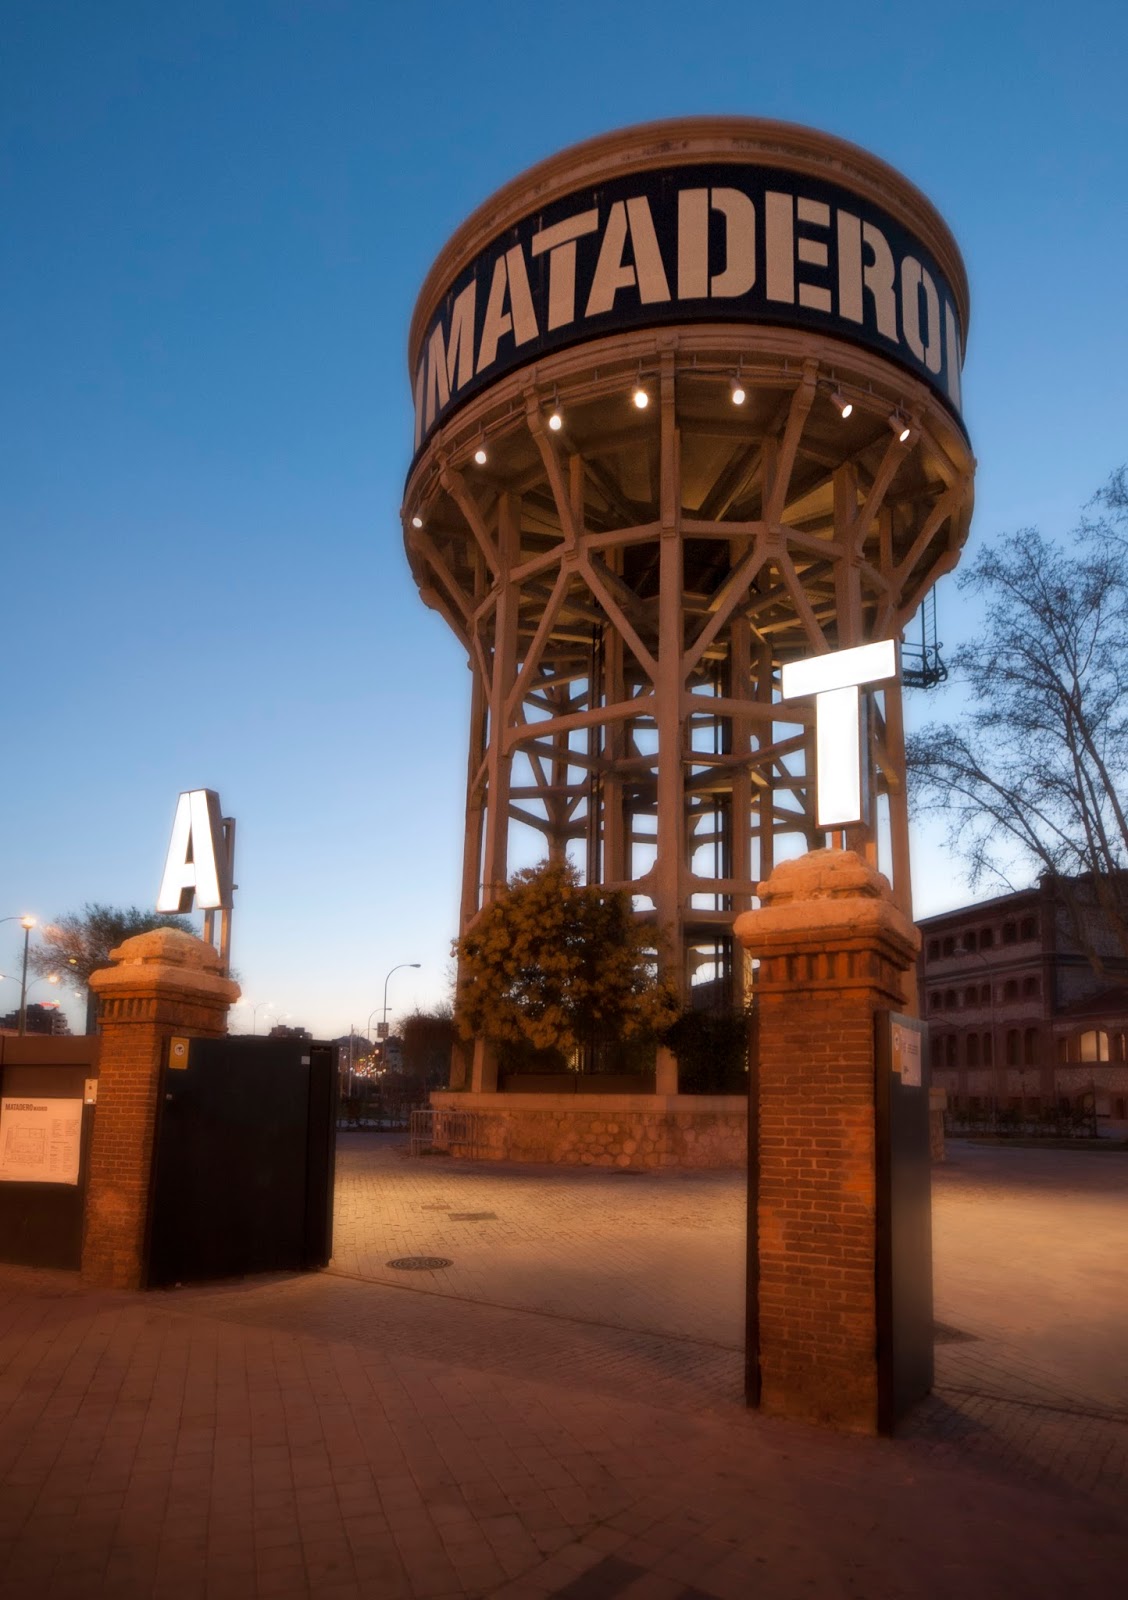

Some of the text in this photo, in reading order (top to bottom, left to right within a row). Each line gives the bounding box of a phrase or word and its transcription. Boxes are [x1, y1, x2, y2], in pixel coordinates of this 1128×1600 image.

[425, 186, 942, 433] MATADERO
[782, 639, 896, 827] T
[156, 789, 222, 913] A
[5, 1103, 33, 1111] MATADERO
